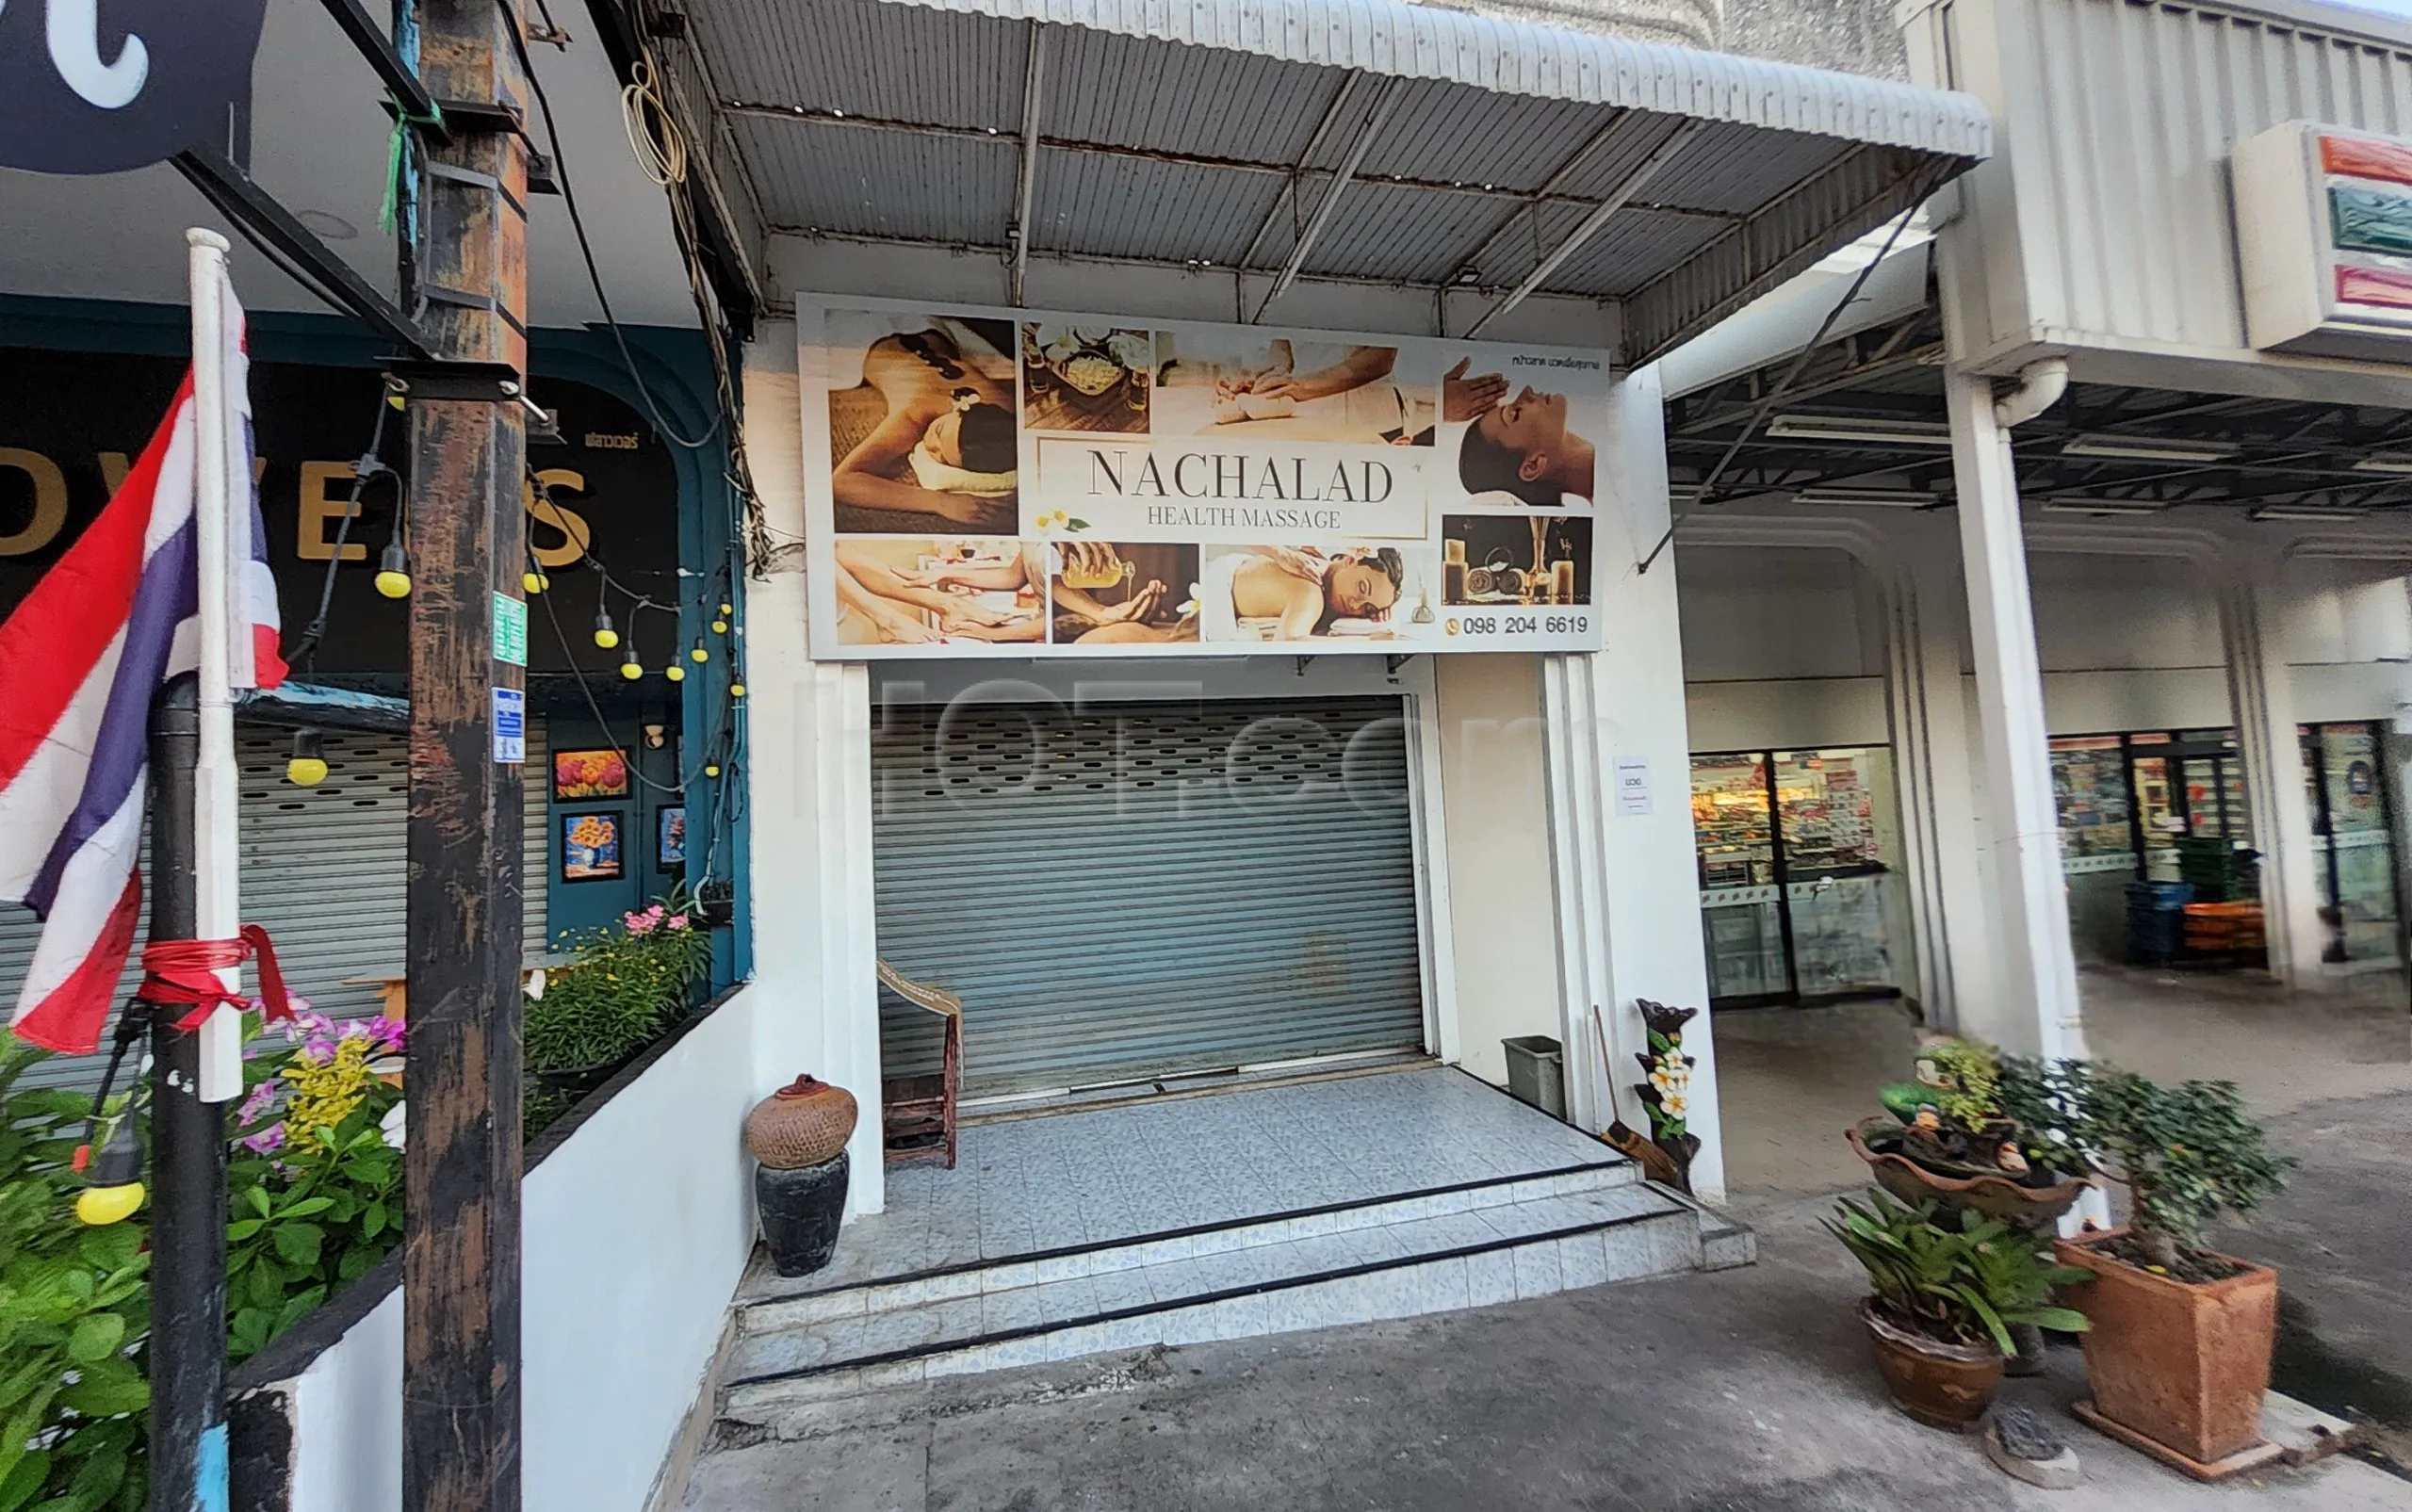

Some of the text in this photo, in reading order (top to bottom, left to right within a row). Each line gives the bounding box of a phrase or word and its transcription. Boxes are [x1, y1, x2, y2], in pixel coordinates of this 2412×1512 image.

[1086, 449, 1393, 503] NACHALAD
[1148, 506, 1341, 528] HEALTH MASSAGE
[1463, 616, 1588, 634] 098 204 6619
